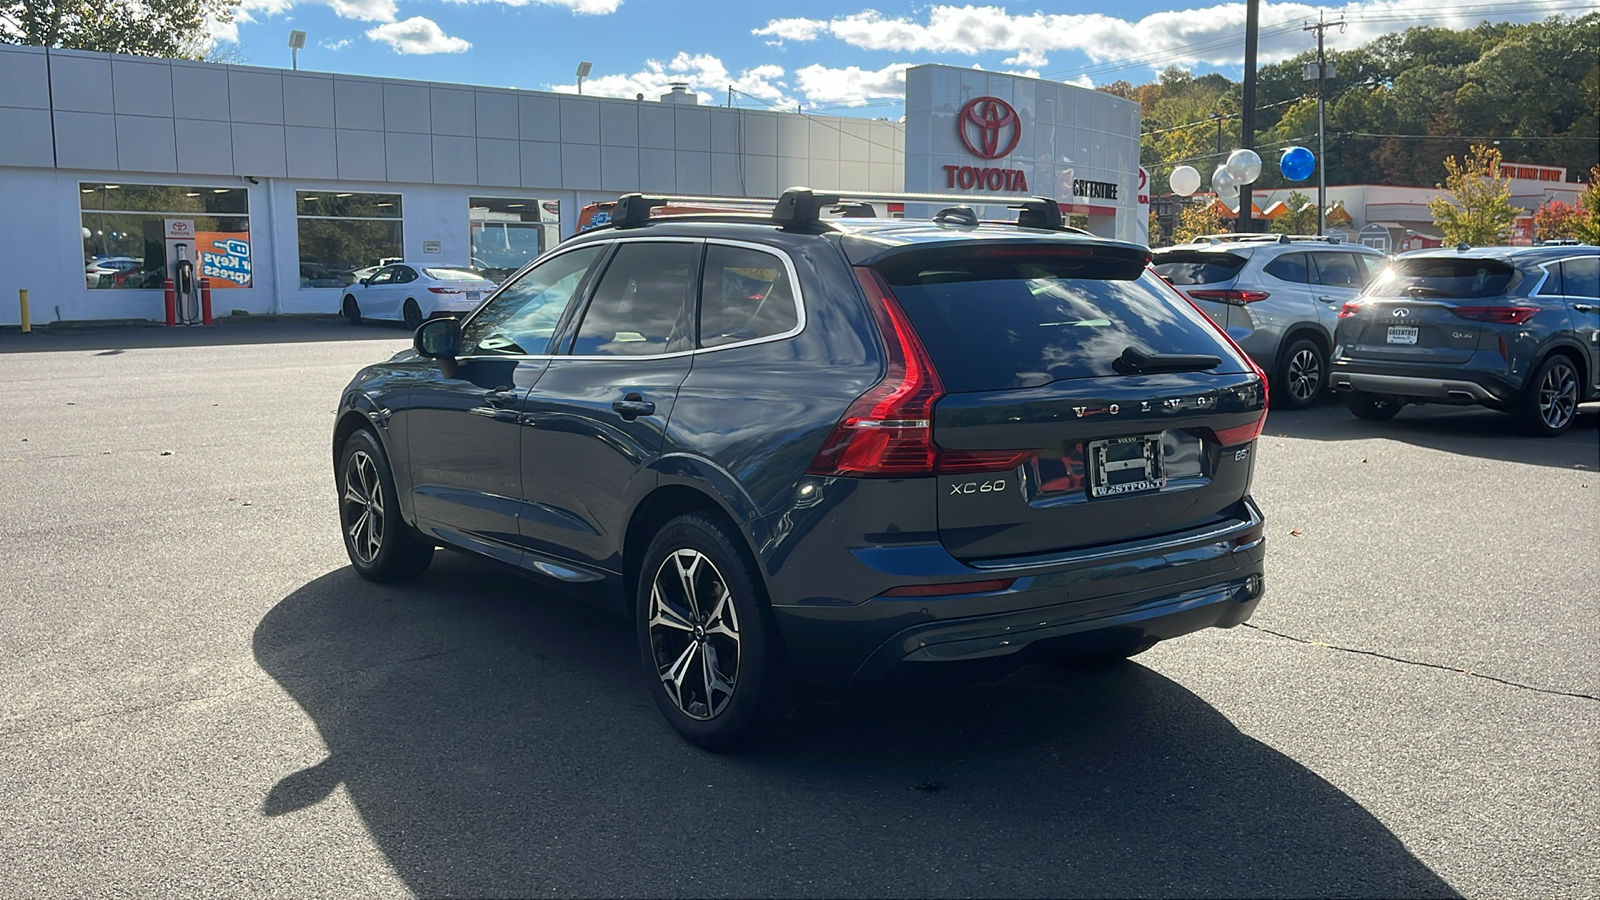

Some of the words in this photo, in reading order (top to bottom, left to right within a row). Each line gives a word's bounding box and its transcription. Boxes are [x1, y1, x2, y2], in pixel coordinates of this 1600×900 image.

[943, 165, 1028, 192] TOYOTA
[1389, 328, 1417, 336] GREENTREE
[1073, 397, 1206, 418] VOLVO
[950, 480, 1006, 495] XC60
[1096, 479, 1162, 496] WESTPORT
